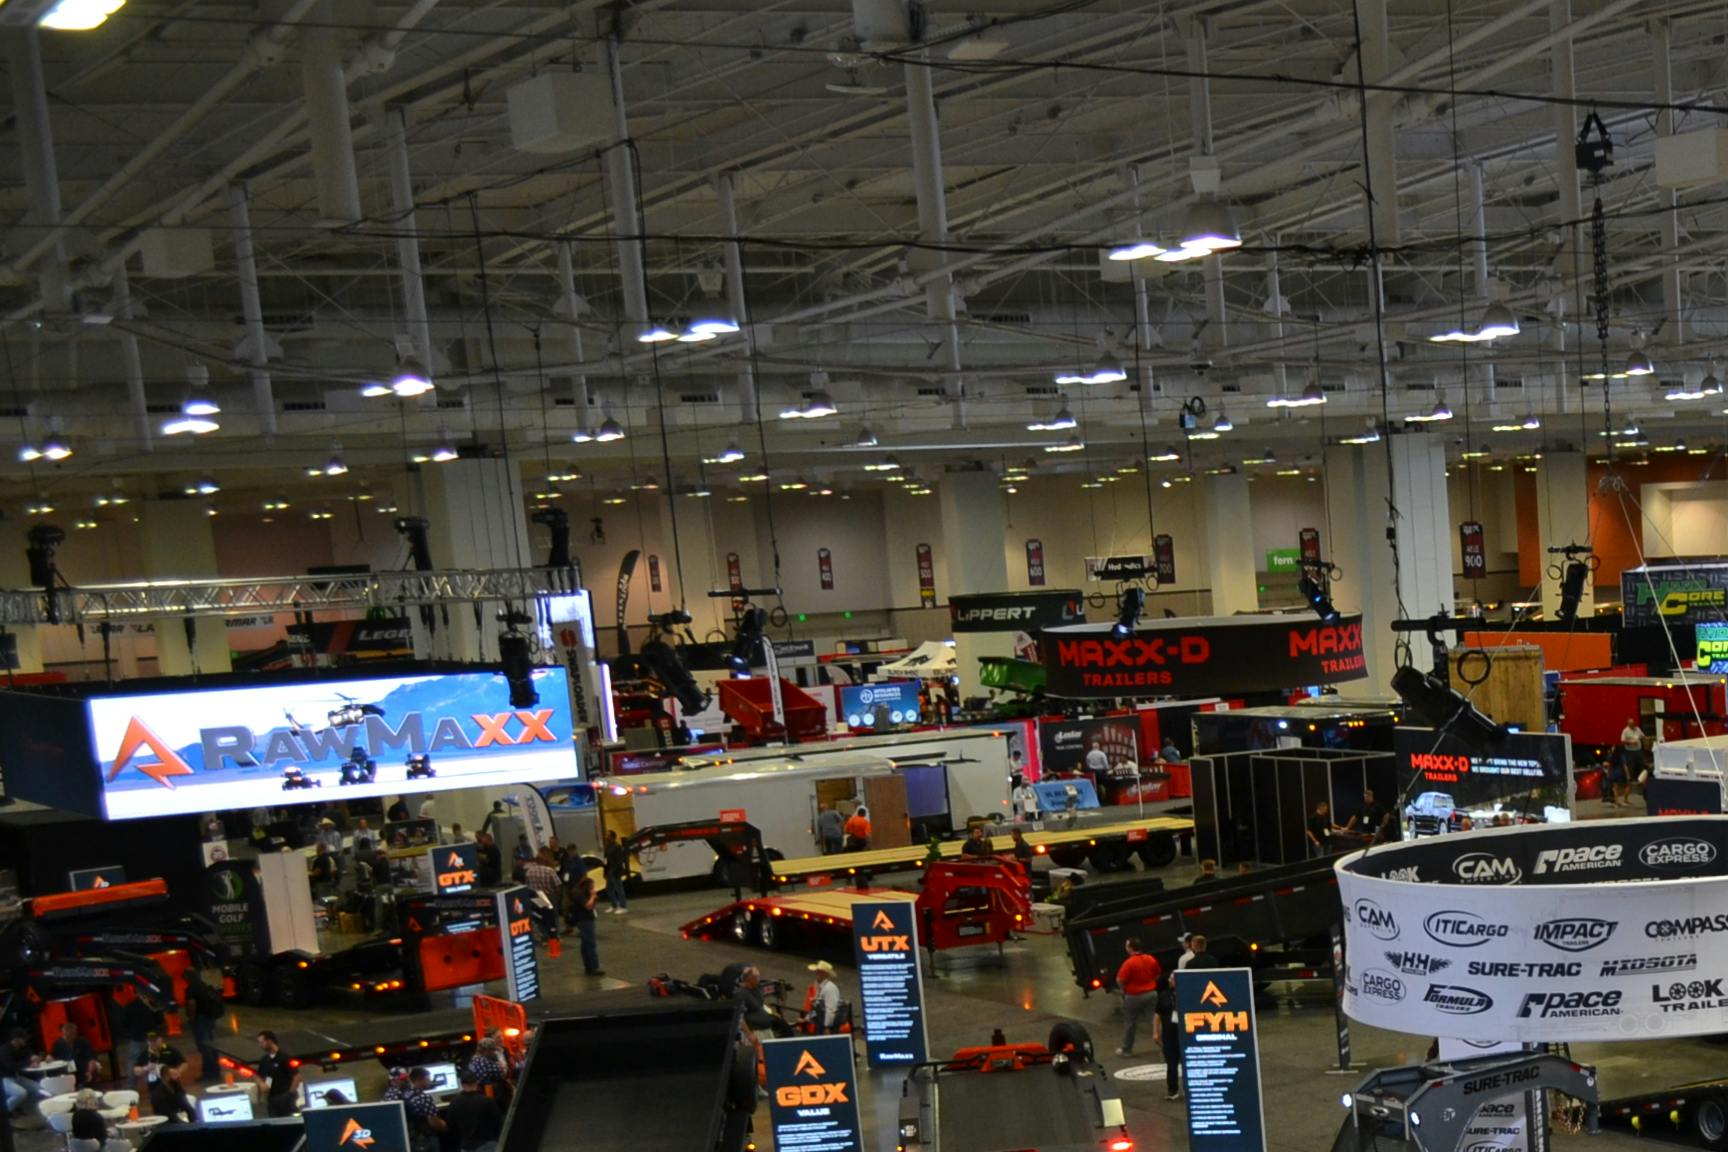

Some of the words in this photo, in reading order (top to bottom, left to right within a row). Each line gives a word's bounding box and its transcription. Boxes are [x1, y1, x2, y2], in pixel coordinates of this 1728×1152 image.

[957, 606, 1037, 622] LIPPERT
[1058, 637, 1210, 668] MAXX-D
[1082, 671, 1173, 688] TRAILERS
[1410, 753, 1470, 774] MAXX-D
[1424, 772, 1461, 783] TRAILERS
[1645, 843, 1710, 856] CARGO
[1562, 860, 1621, 871] AMERICAN
[1646, 853, 1710, 865] EXPRESS
[1459, 857, 1516, 879] CAM
[438, 870, 476, 887] GTX
[211, 903, 249, 914] MOBILE
[219, 914, 245, 924] GOLF
[1358, 906, 1396, 929] CAM
[510, 918, 531, 937] DTX
[1534, 920, 1619, 940] IMPACT
[861, 935, 911, 952] UTX
[1467, 962, 1583, 978] SURE-TRAC
[1600, 954, 1697, 977] MIDSOTA
[1363, 973, 1401, 992] CARGO
[1652, 979, 1725, 1003] LOOK
[1363, 985, 1401, 1001] EXPRESS
[1424, 983, 1486, 1007] FORMULA
[1549, 1008, 1621, 1018] AMERICAN
[1184, 1011, 1249, 1033] FYH
[1463, 1065, 1540, 1095] SURE-TRAC
[776, 1082, 849, 1108] GDX
[797, 1107, 831, 1118] VALUE
